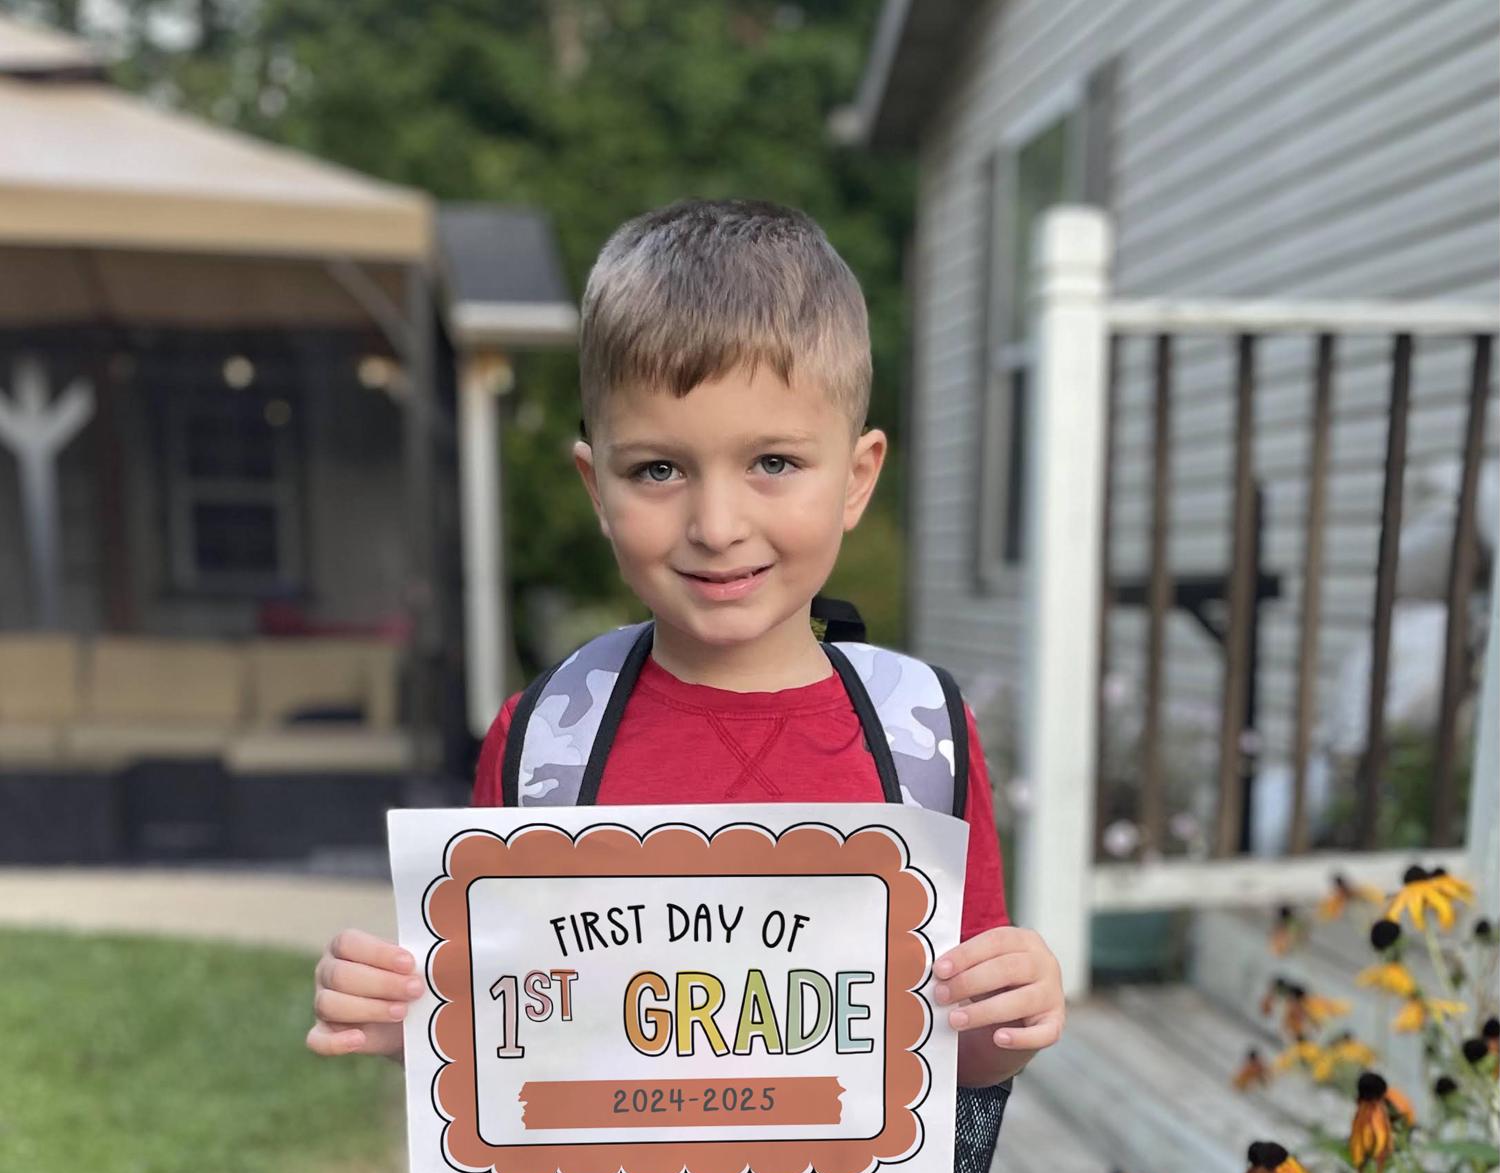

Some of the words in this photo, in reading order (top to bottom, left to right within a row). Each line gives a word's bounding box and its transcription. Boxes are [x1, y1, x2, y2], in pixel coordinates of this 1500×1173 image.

[549, 904, 646, 957] FIRST
[666, 903, 744, 944] DAY
[762, 910, 810, 953] OF
[489, 969, 579, 1059] 1ST
[623, 968, 875, 1057] GRADE
[612, 1086, 777, 1114] 2024-2025
